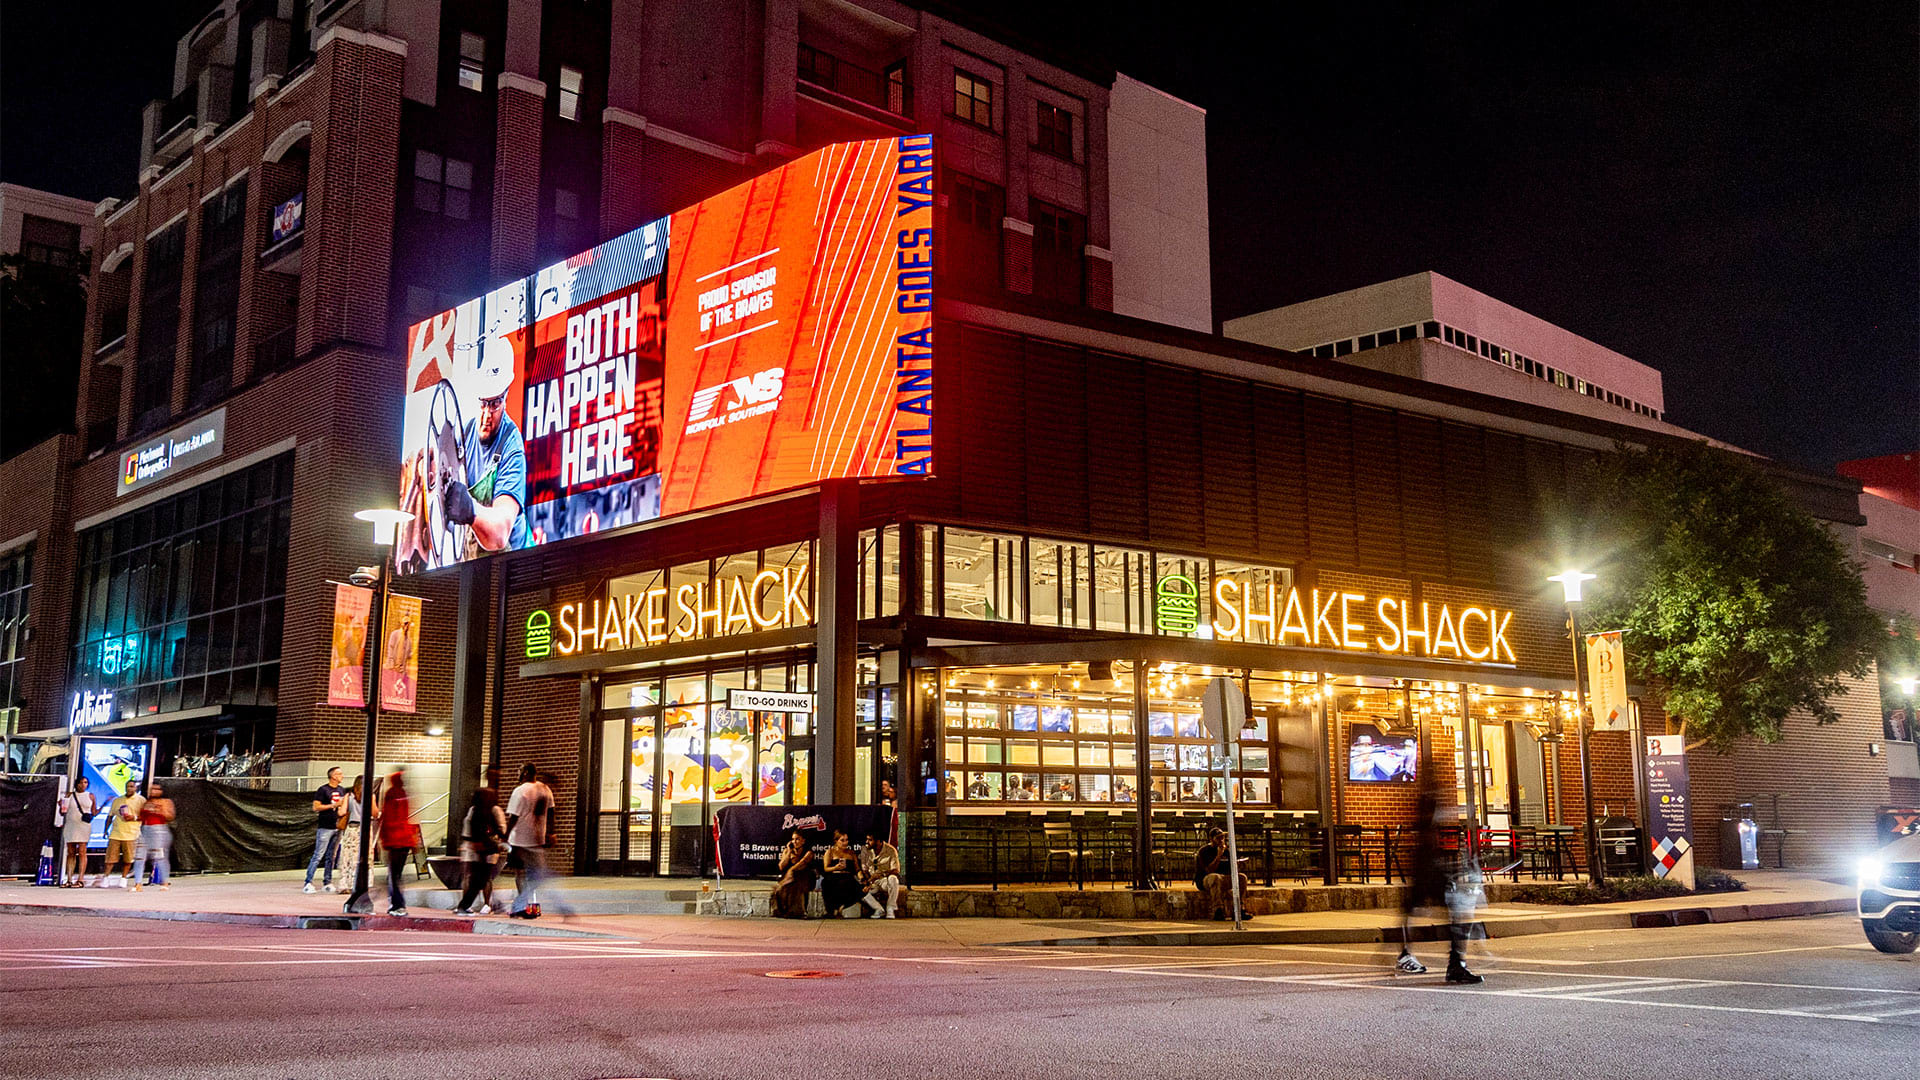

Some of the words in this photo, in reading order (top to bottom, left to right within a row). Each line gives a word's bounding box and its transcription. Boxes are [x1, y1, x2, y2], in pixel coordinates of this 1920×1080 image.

[898, 134, 932, 218] YARD
[698, 284, 729, 312] PROUD
[731, 267, 777, 301] SPONSOR
[897, 228, 932, 314] GOES
[565, 292, 639, 372] BOTH
[700, 311, 713, 333] OF
[715, 304, 733, 328] THE
[735, 290, 773, 320] BRAVES
[526, 351, 637, 441] HAPPEN
[685, 415, 725, 435] NORFOLK
[728, 400, 779, 424] SOUTHERN
[897, 327, 932, 475] ATLANTA
[560, 412, 635, 489] HERE
[557, 588, 668, 654] SHAKE
[675, 564, 812, 638] SHACK
[1212, 579, 1368, 649] SHAKE
[1377, 597, 1516, 662] SHACK
[748, 696, 775, 706] TO-GO
[777, 699, 808, 708] DRINKS
[1650, 739, 1662, 756] B
[743, 852, 777, 860] National
[752, 844, 779, 852] Braves
